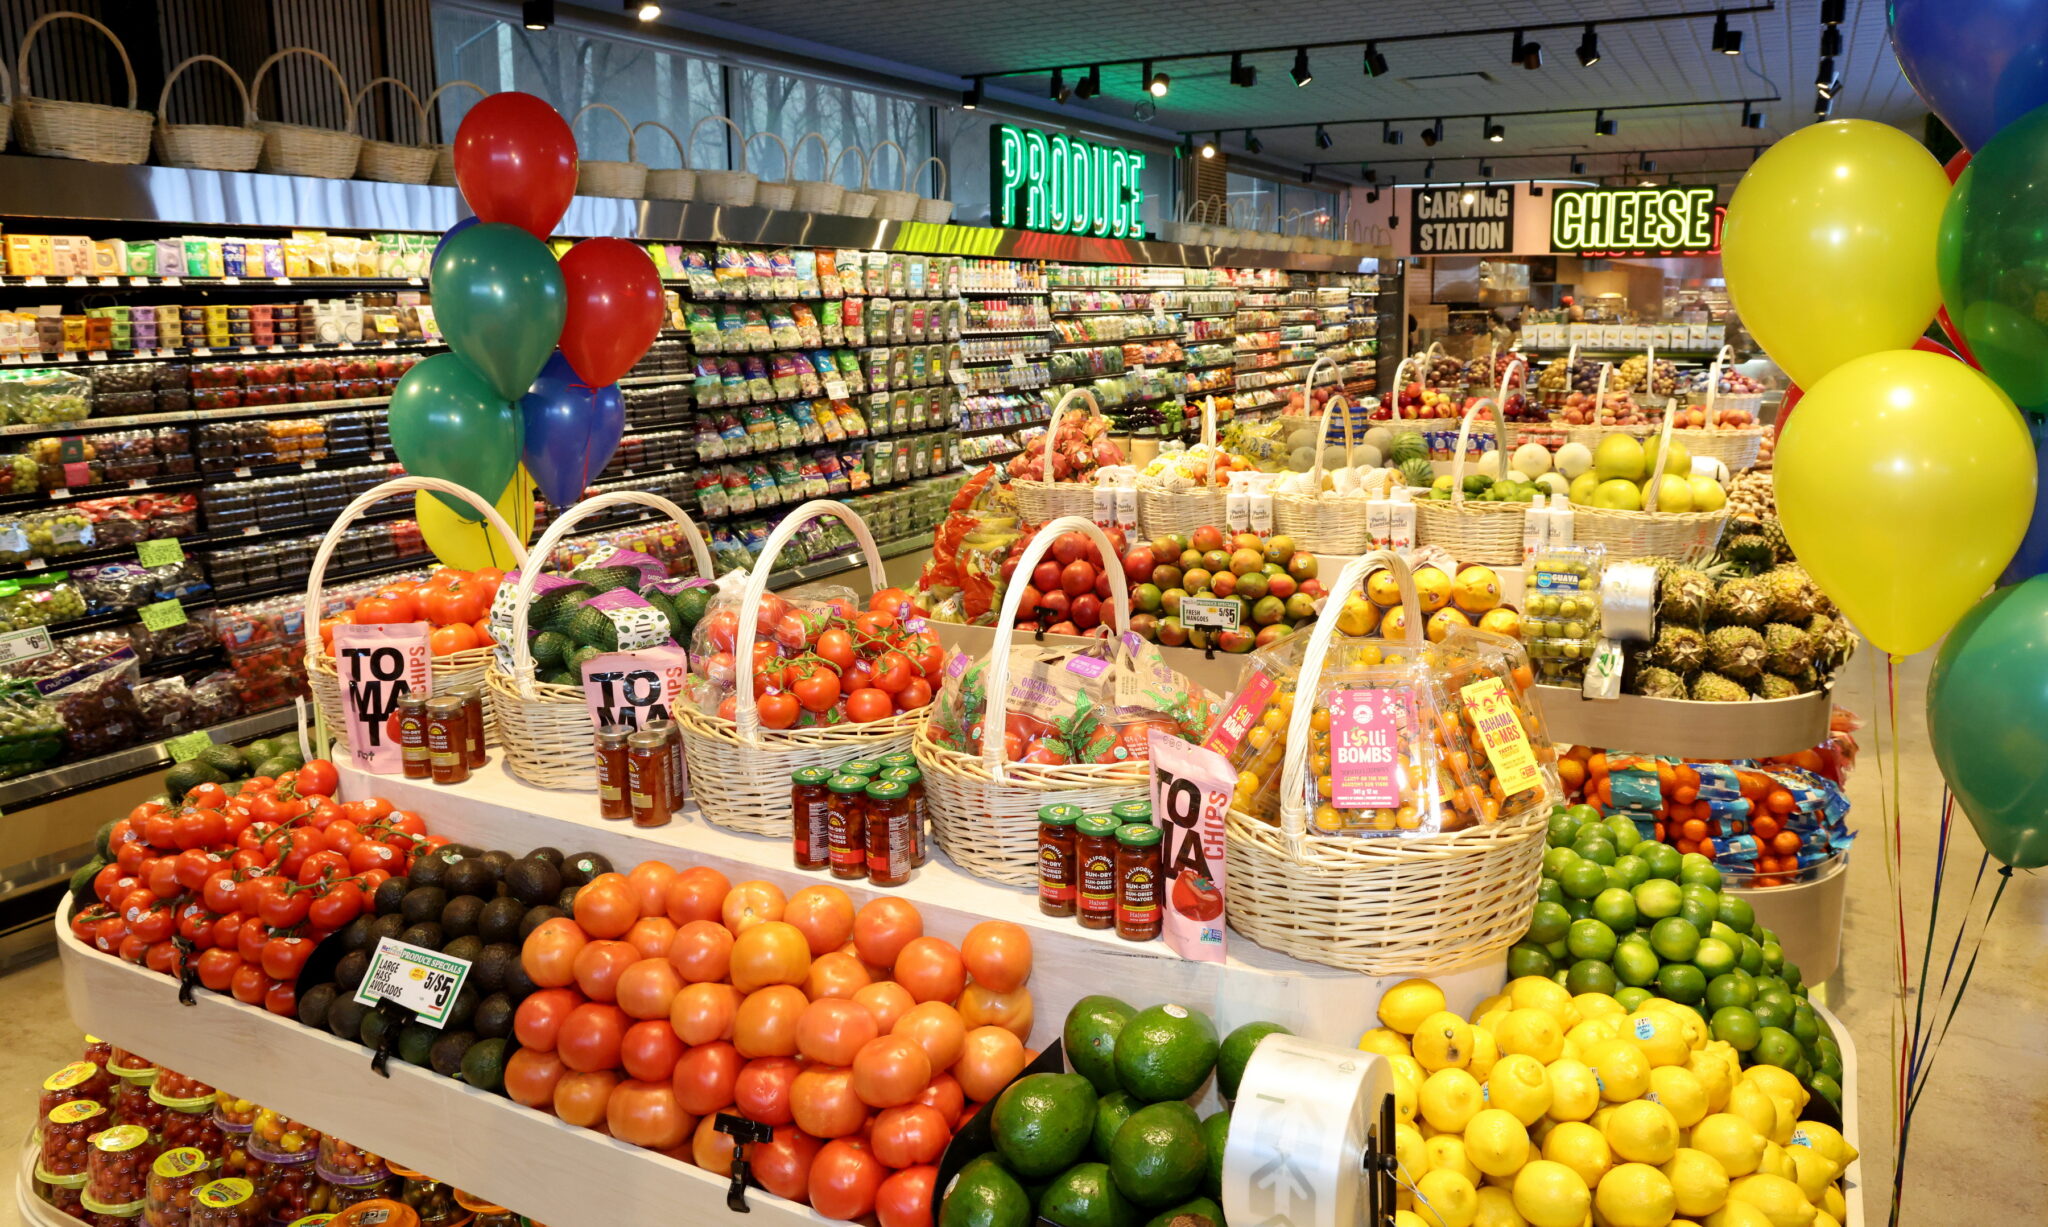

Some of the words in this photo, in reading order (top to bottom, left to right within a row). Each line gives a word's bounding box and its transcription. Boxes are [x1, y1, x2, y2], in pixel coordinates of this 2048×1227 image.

[1001, 123, 1146, 239] PRODUCE
[1417, 188, 1509, 220] CARVING
[1554, 190, 1714, 249] CHEESE
[1419, 221, 1505, 251] STATION
[1551, 574, 1579, 583] GUAVA
[1185, 615, 1210, 623] MANGOES
[341, 647, 405, 683] TO
[409, 646, 427, 699] CHIPS
[588, 669, 662, 707] TO
[1479, 711, 1514, 733] BAHAMA
[1485, 725, 1521, 749] BOMBS
[1338, 747, 1392, 763] BOMBS
[1156, 768, 1201, 829] TO
[1203, 790, 1228, 860] CHIPS
[1084, 855, 1114, 869] CALIFORNIA
[1125, 866, 1155, 881] CALIFORNIA
[379, 959, 401, 974] LARGE
[401, 950, 432, 966] PRODUCE
[430, 959, 463, 975] SPECIALS
[374, 969, 392, 983] HASS
[368, 980, 404, 999] AVOCADOS
[423, 971, 455, 1007] 5/$5
